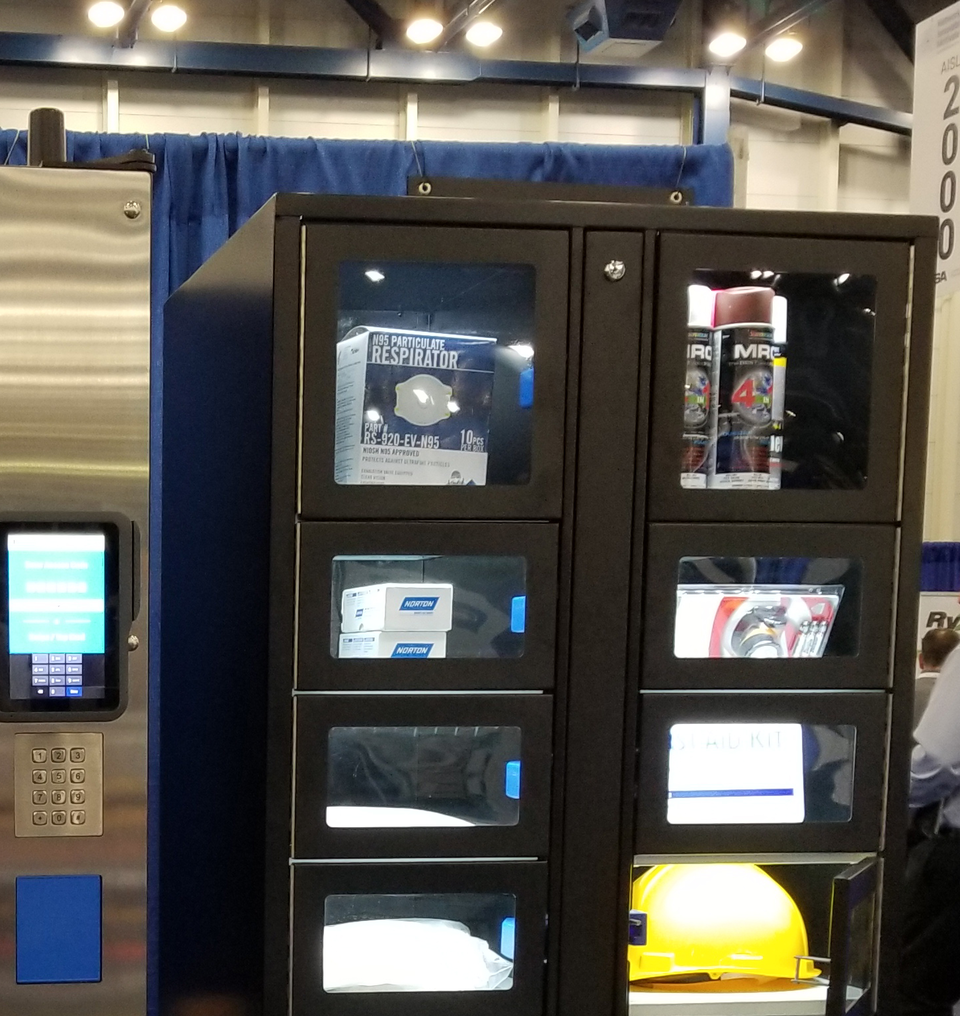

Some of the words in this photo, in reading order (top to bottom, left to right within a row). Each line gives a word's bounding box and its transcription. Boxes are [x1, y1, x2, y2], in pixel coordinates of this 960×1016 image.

[372, 334, 389, 347] N95
[391, 335, 445, 351] PARTICULATE
[371, 346, 459, 369] RESPIRATOR
[364, 422, 382, 433] PART
[364, 432, 440, 449] RS-920-EV-N95
[404, 600, 435, 608] NORTON
[396, 646, 429, 655] NORTON
